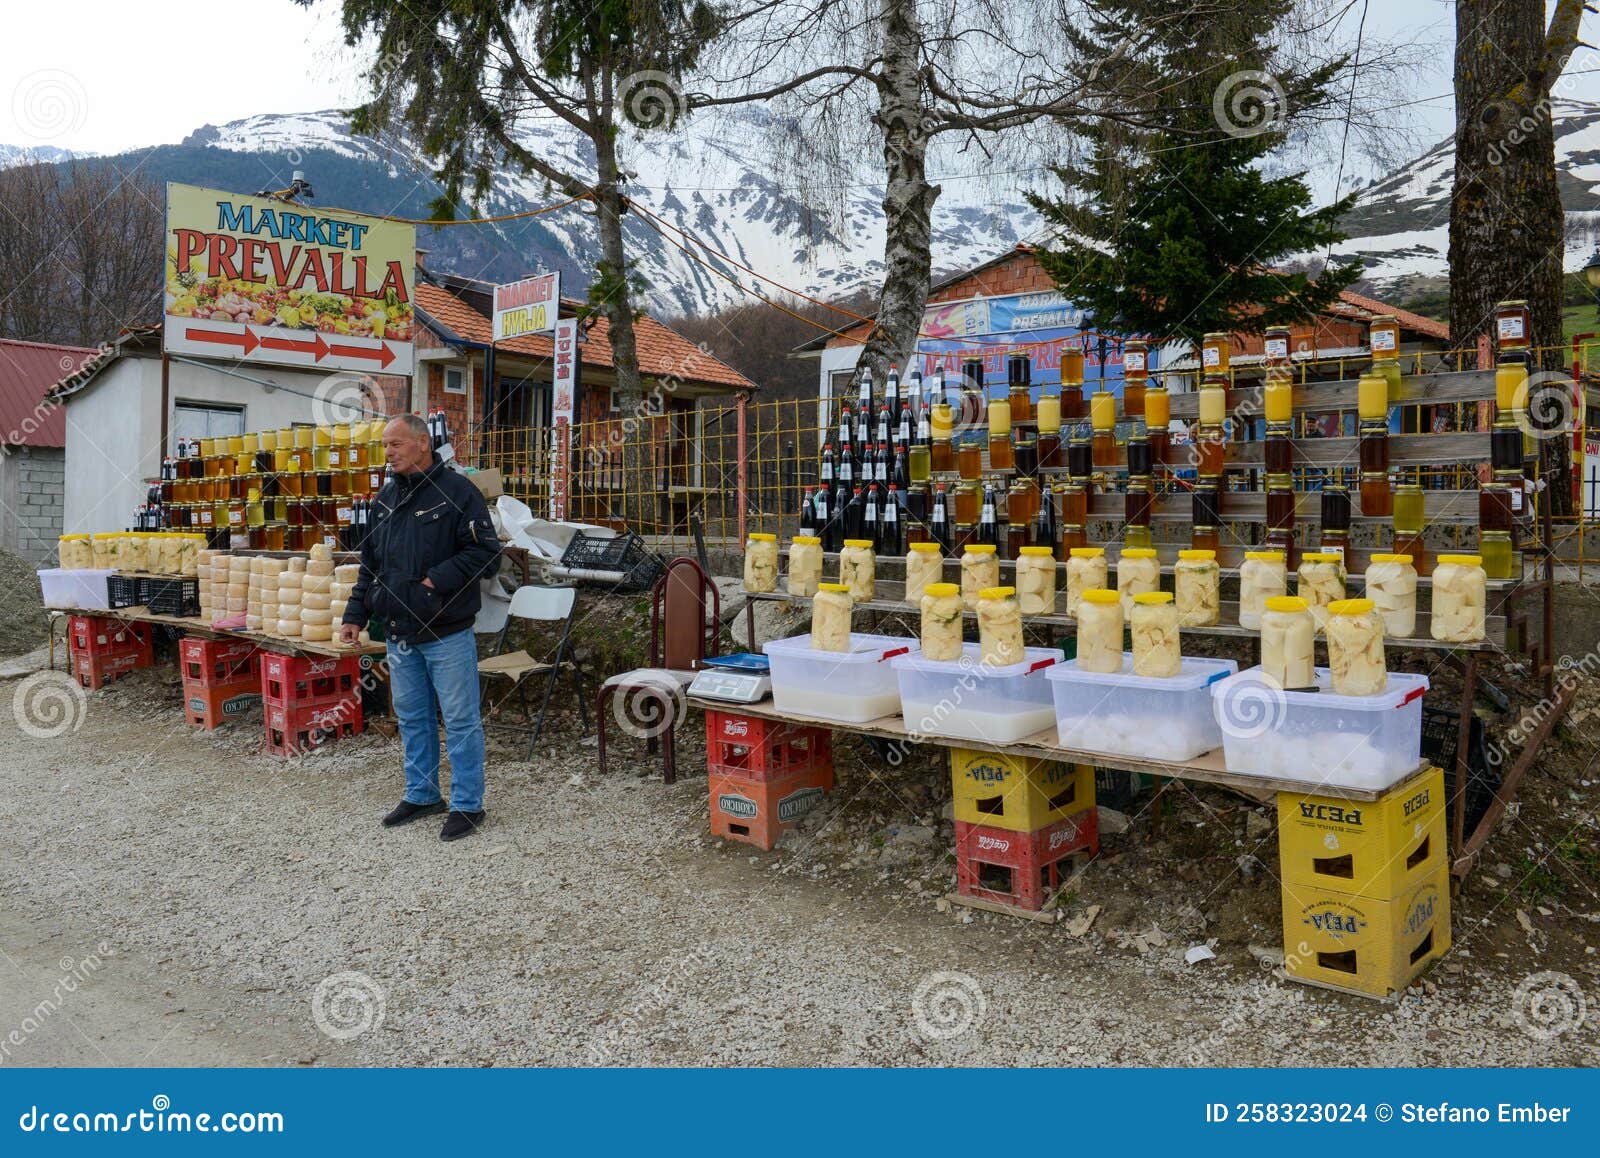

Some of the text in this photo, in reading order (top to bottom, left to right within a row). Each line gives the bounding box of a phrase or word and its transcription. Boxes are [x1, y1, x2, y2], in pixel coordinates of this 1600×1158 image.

[217, 201, 368, 250] MARKET
[173, 228, 409, 303] PREVALLA
[497, 274, 554, 312] MARKET
[502, 304, 546, 337] HYRJA
[971, 765, 1005, 783] PEJA
[1298, 801, 1363, 826] PEJA
[1403, 789, 1431, 817] PEJA
[1309, 911, 1359, 935] PEJA
[1408, 896, 1434, 934] PEJA
